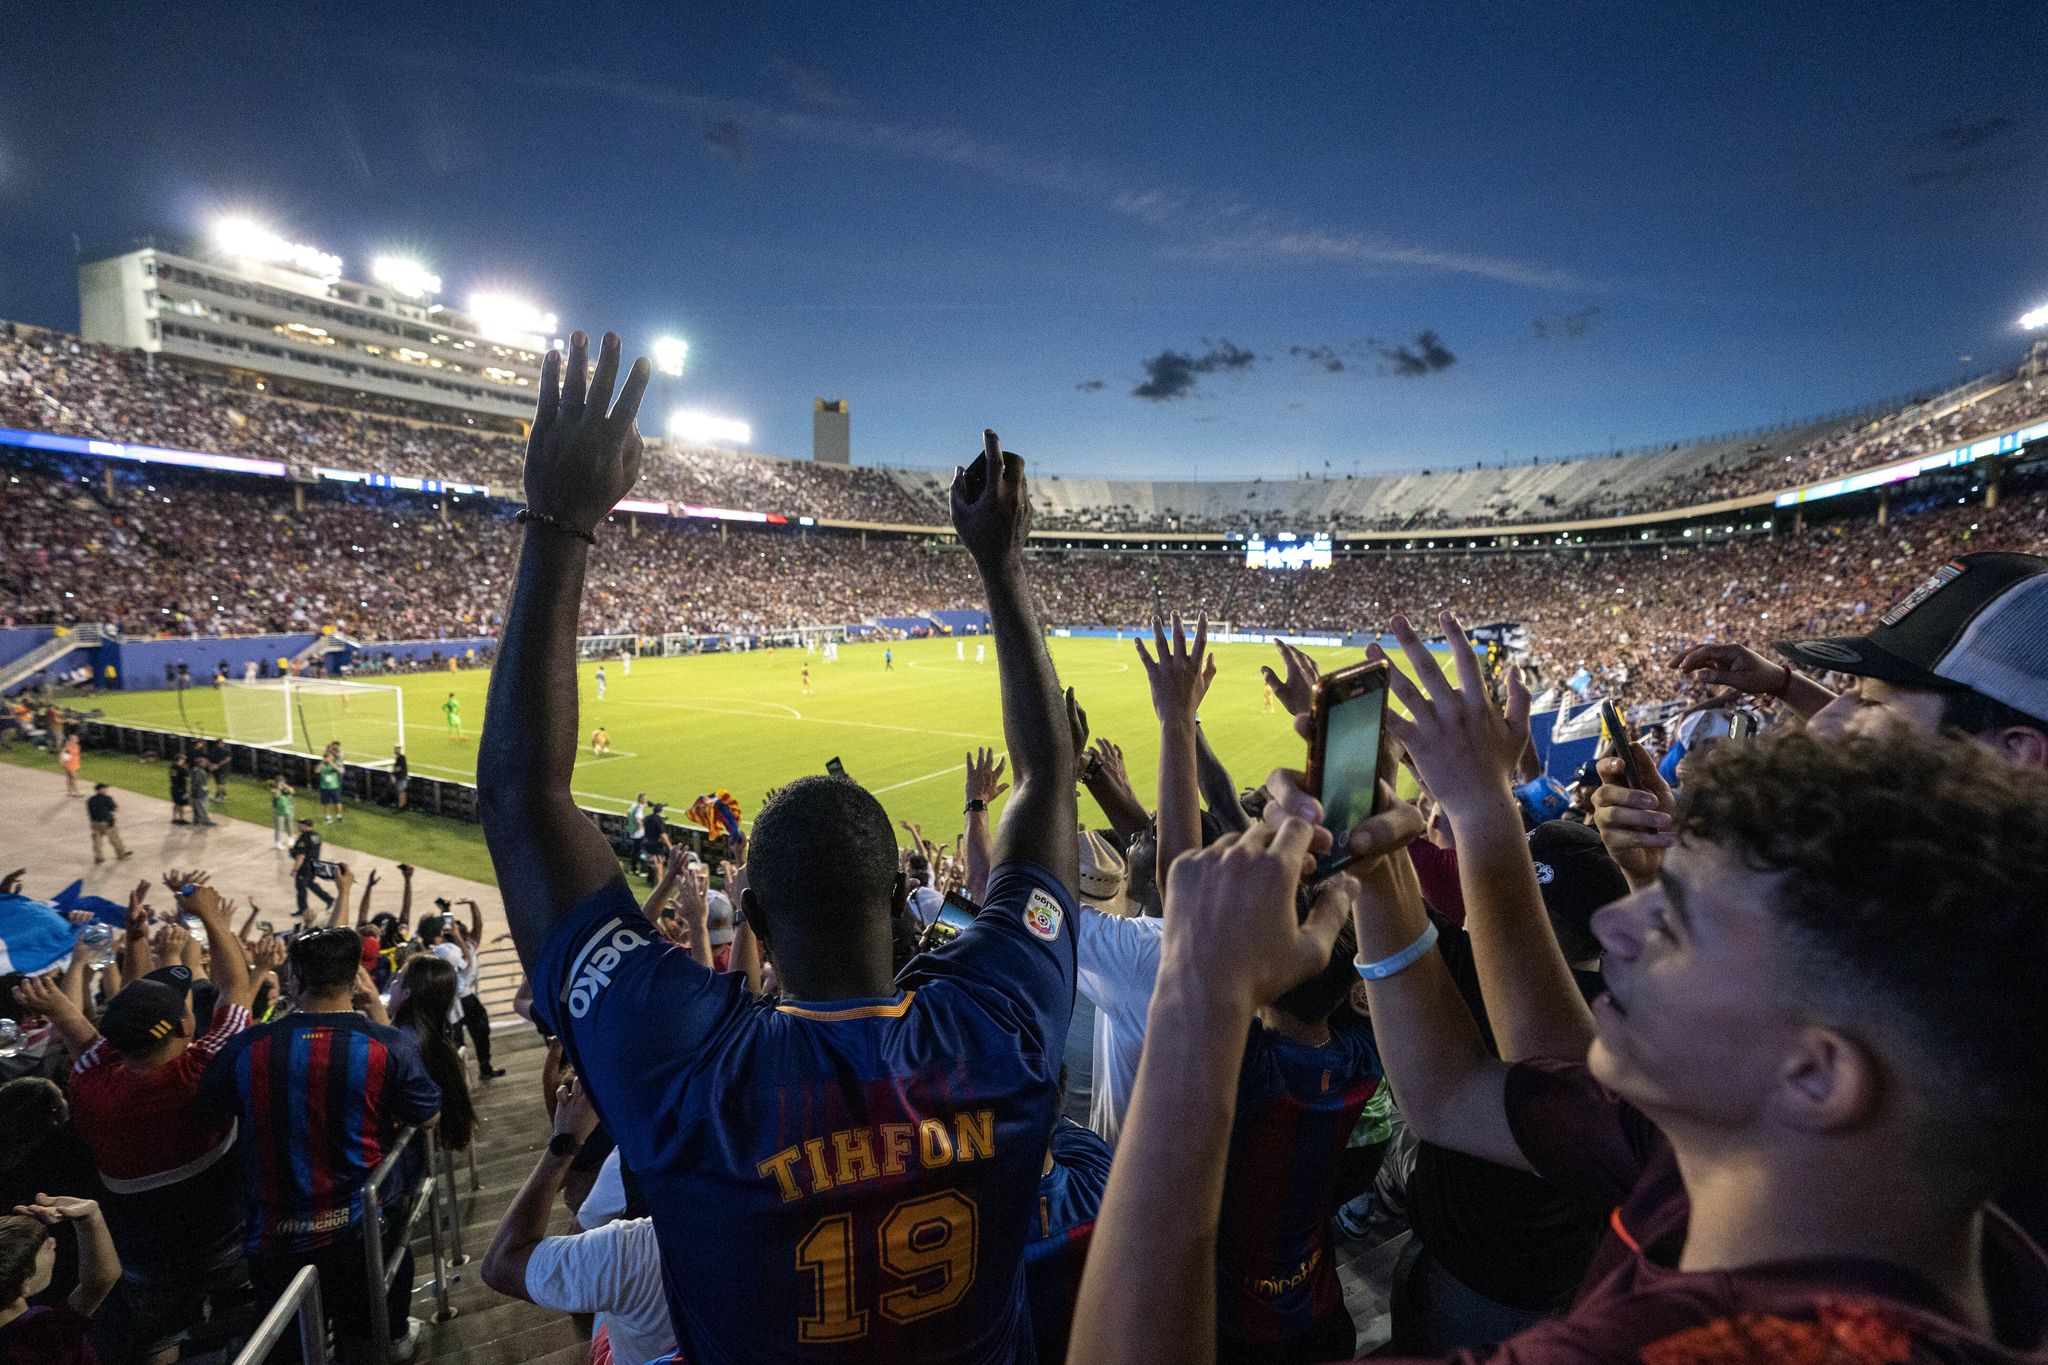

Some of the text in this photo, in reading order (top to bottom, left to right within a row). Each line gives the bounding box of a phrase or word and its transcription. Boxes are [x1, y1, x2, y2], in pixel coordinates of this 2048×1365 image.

[568, 929, 651, 1019] beko
[756, 1109, 995, 1203] TIHFON
[796, 1188, 979, 1343] 19
